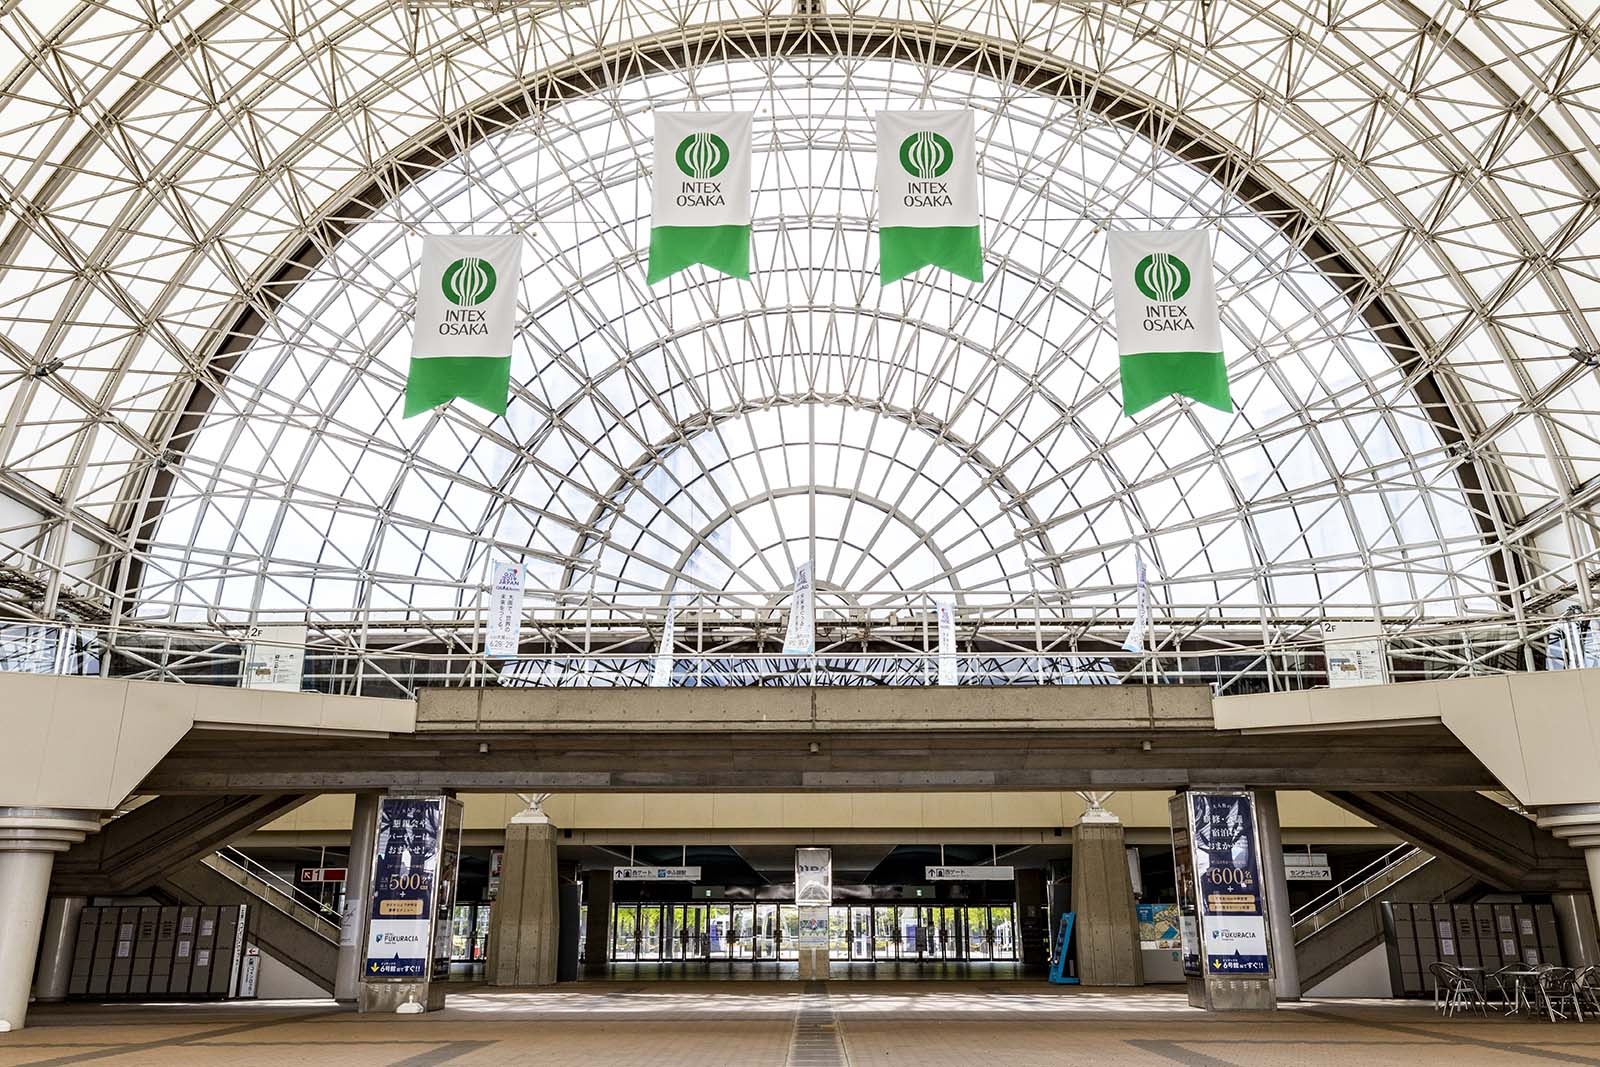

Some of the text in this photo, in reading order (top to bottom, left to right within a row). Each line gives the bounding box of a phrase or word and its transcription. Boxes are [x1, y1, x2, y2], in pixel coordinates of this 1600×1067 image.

[682, 181, 721, 194] INTEX
[908, 181, 948, 194] INTEX
[676, 194, 725, 207] OSAKA
[904, 195, 953, 207] OSAKA
[445, 309, 487, 322] INTEX
[1146, 305, 1188, 318] INTEX
[439, 322, 489, 336] OSAKA
[1143, 318, 1195, 332] OSAKA
[251, 627, 263, 637] 2F
[1324, 623, 1336, 632] 2F
